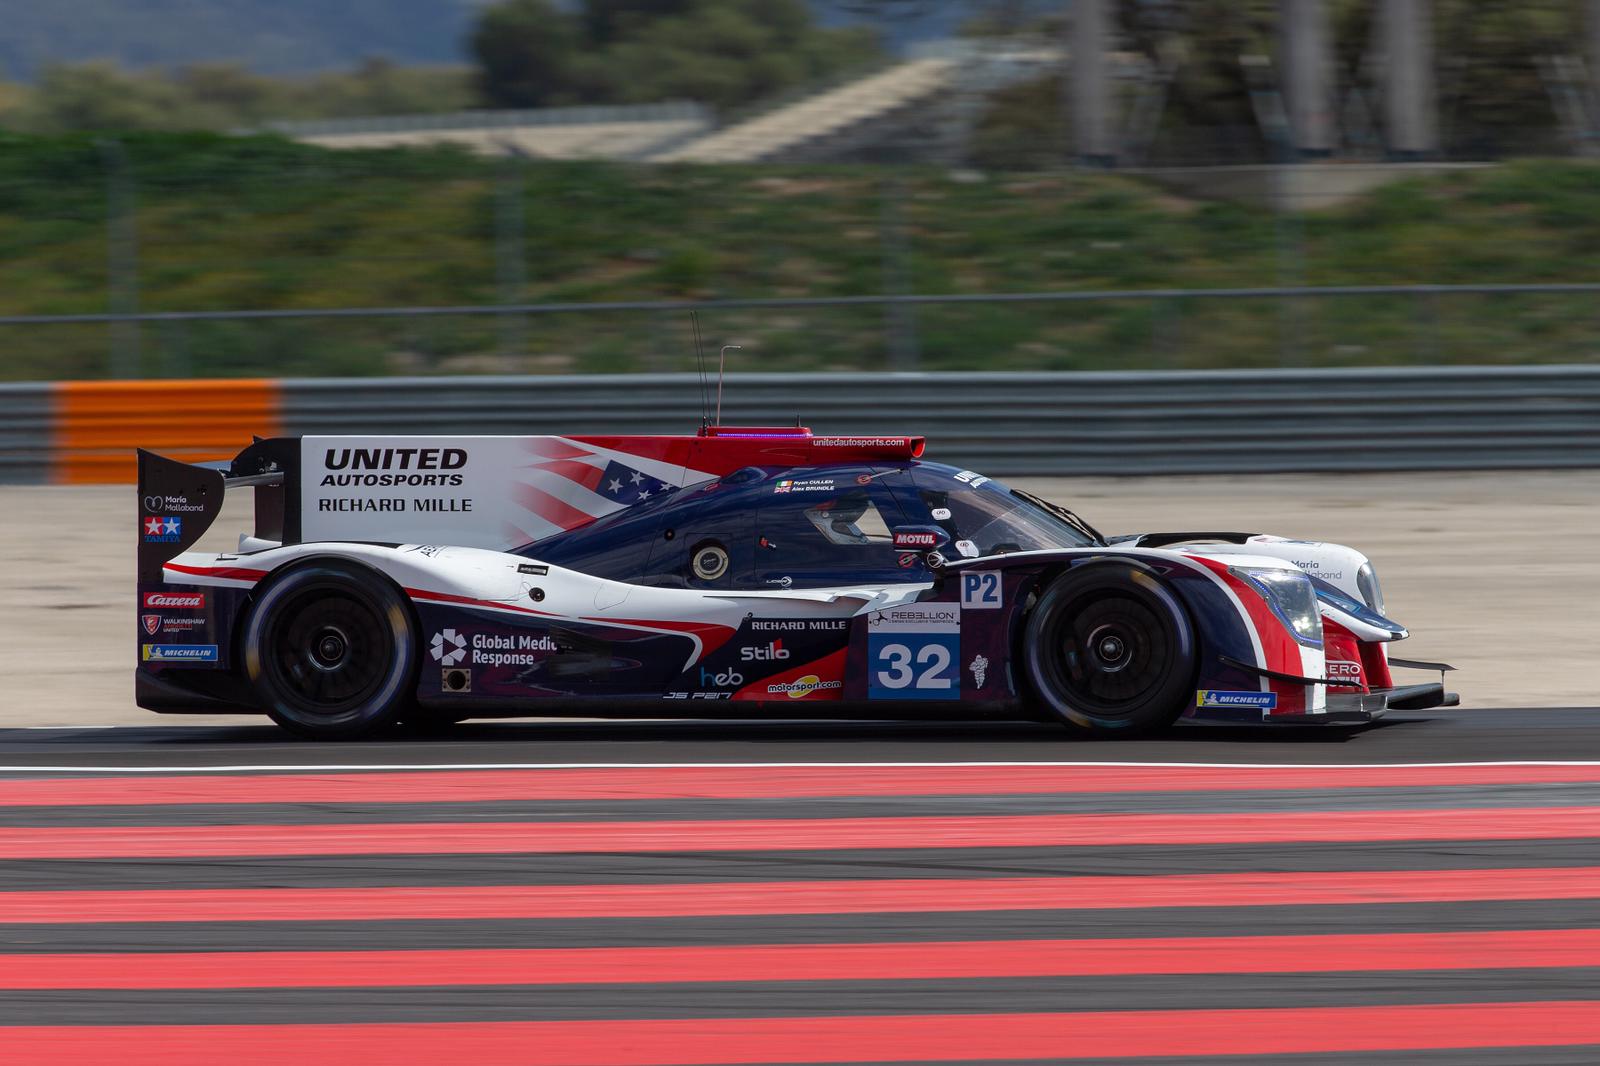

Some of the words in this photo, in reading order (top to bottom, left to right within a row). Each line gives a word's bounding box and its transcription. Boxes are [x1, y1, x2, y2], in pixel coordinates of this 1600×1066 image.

[813, 437, 905, 447] unitedautosports.com
[324, 448, 468, 470] UNITED
[320, 474, 464, 487] AUTOSPORTS
[165, 495, 187, 503] Maria
[318, 498, 406, 512] RICHARD
[413, 498, 473, 512] MILLE
[164, 504, 204, 512] Mallaband
[896, 533, 935, 545] MOTUL
[964, 573, 999, 603] P2
[147, 594, 201, 606] Carrera
[891, 611, 954, 620] REBELLION
[751, 621, 806, 631] RICHARD
[809, 620, 847, 630] MILLE
[472, 634, 515, 650] Global
[164, 649, 212, 657] MICHELIN
[740, 638, 790, 661] Stilo
[472, 650, 534, 667] Response
[877, 643, 952, 689] 32
[1325, 664, 1360, 674] ERO
[701, 666, 744, 687] heb
[767, 680, 842, 694] motorsport.com
[1219, 695, 1271, 705] MICHELIN
